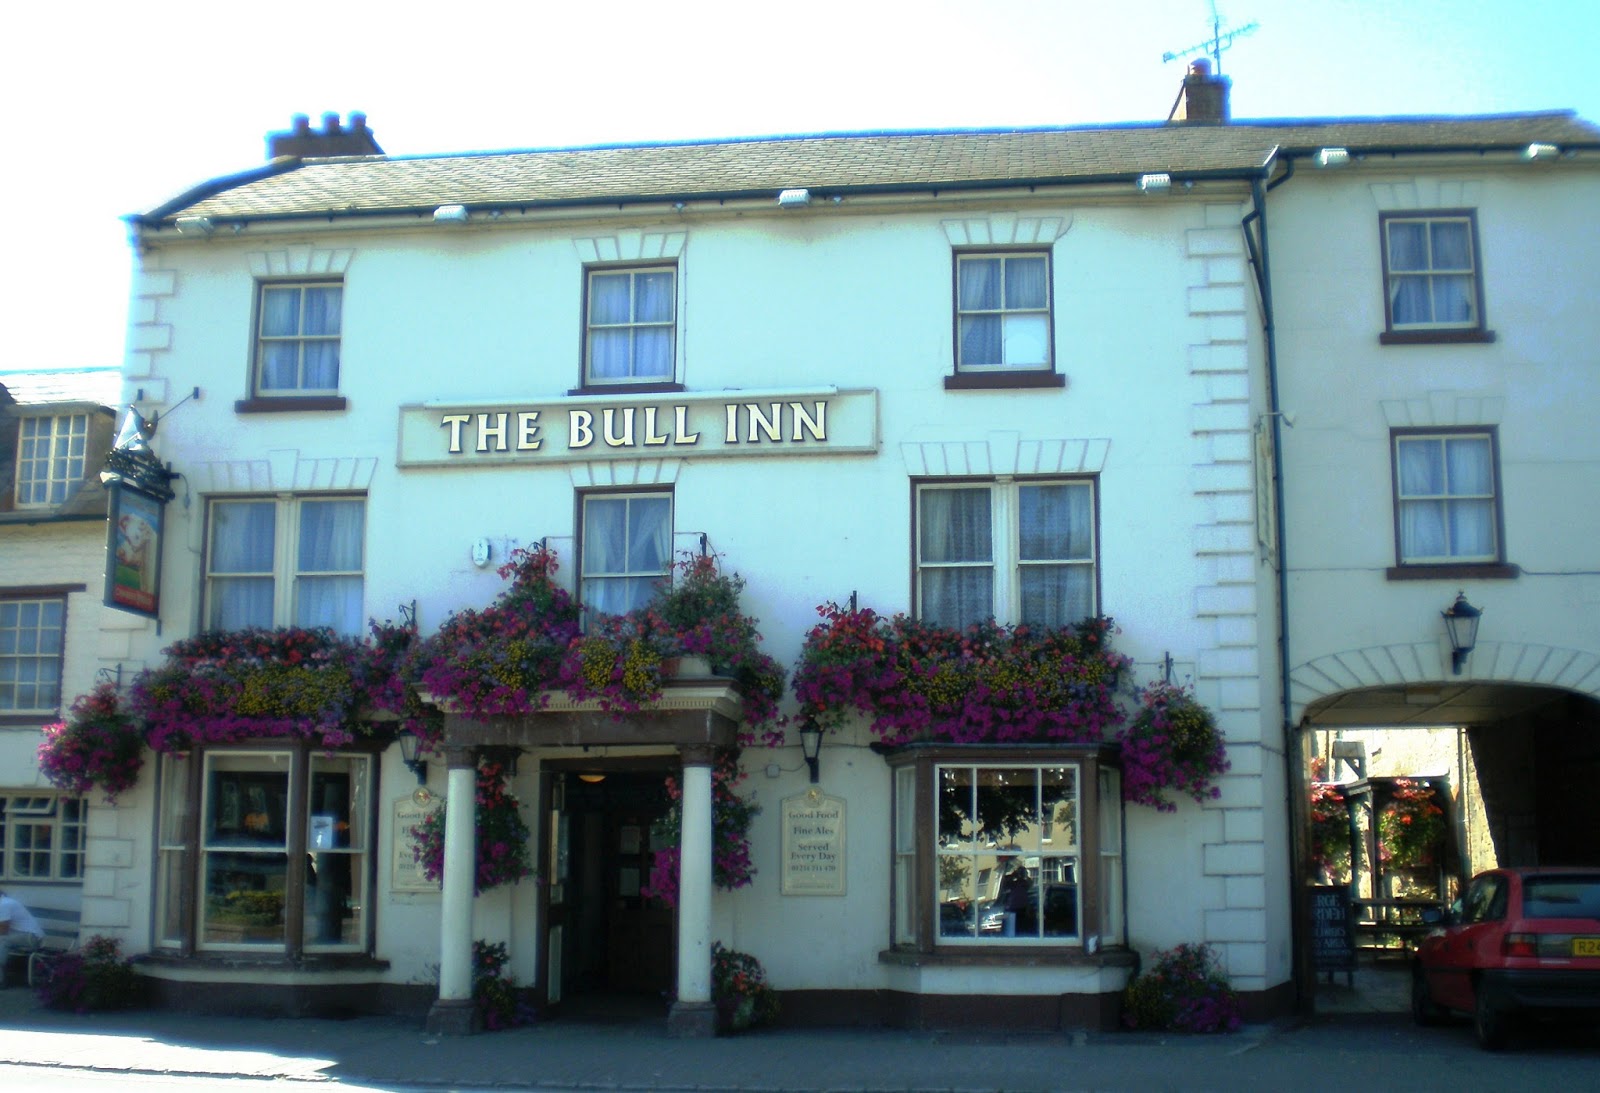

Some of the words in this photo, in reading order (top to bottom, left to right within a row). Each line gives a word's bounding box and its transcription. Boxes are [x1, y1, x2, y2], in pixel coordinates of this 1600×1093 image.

[440, 410, 544, 454] THE
[567, 406, 701, 449] BULL
[724, 400, 829, 444] INN
[788, 810, 814, 819] Good
[816, 810, 839, 819] Food
[793, 826, 813, 835] Fine
[815, 826, 834, 835] Ales
[798, 843, 829, 851] Served
[791, 852, 817, 863] Every
[819, 852, 837, 863] Day
